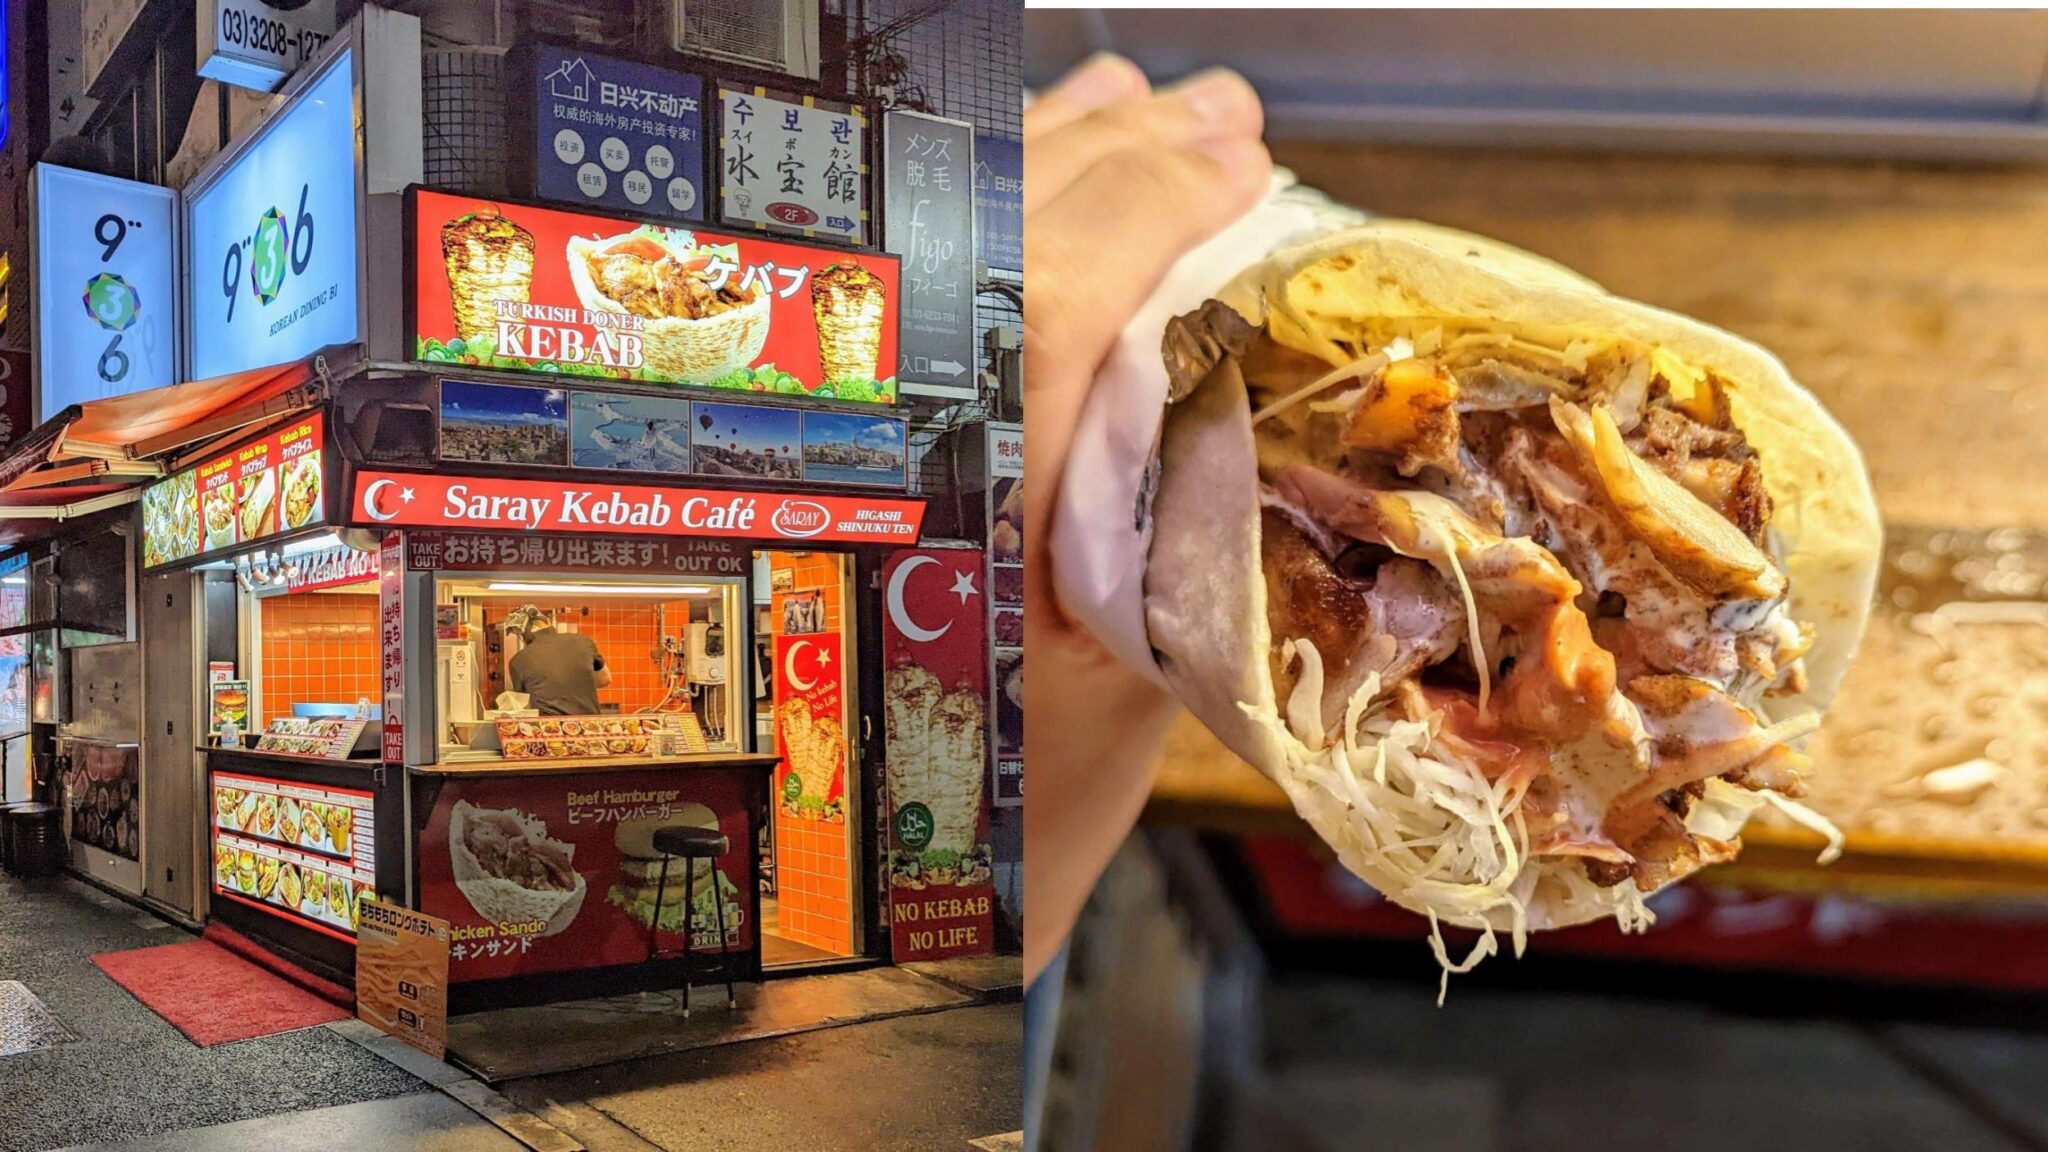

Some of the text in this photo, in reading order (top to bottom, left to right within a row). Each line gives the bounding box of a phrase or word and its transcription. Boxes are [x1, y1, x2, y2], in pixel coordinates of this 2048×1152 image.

[223, 8, 330, 62] 03)3208-127
[600, 81, 698, 119] 日兴不动产
[553, 103, 696, 142] 权威的海外房产投资专家!
[559, 140, 579, 153] 投资
[905, 133, 952, 161] メンズ
[906, 160, 952, 192] 脱毛
[784, 208, 799, 222] 2F
[902, 200, 954, 274] figo
[704, 254, 809, 300] ケバブ
[269, 309, 299, 337] KOREAN
[493, 299, 644, 331] TURKISH DONER
[495, 320, 644, 369] KEBAB
[900, 354, 929, 374] 入口
[443, 484, 756, 530] Saray Kebab Café
[780, 508, 820, 527] SARAY
[855, 509, 902, 522] HIGASHI
[836, 521, 914, 535] SHINJUKU TEN
[410, 542, 442, 556] TAKE
[443, 537, 669, 567] お持ち帰り出来ます!
[688, 541, 731, 553] TAKE
[414, 555, 437, 569] OUT
[674, 555, 743, 572] OUT OK
[385, 732, 402, 746] TAKE
[387, 746, 401, 759] OUT
[567, 789, 680, 806] Beef Hamburger
[568, 803, 682, 824] ビーフハンバーガー
[903, 831, 925, 840] HALAL
[895, 897, 990, 923] NO KEBAB
[450, 924, 495, 941] icken
[499, 919, 547, 936] Sando
[694, 934, 729, 946] DRIN
[909, 927, 978, 950] NO LIFE
[449, 936, 533, 961] キンサンド
